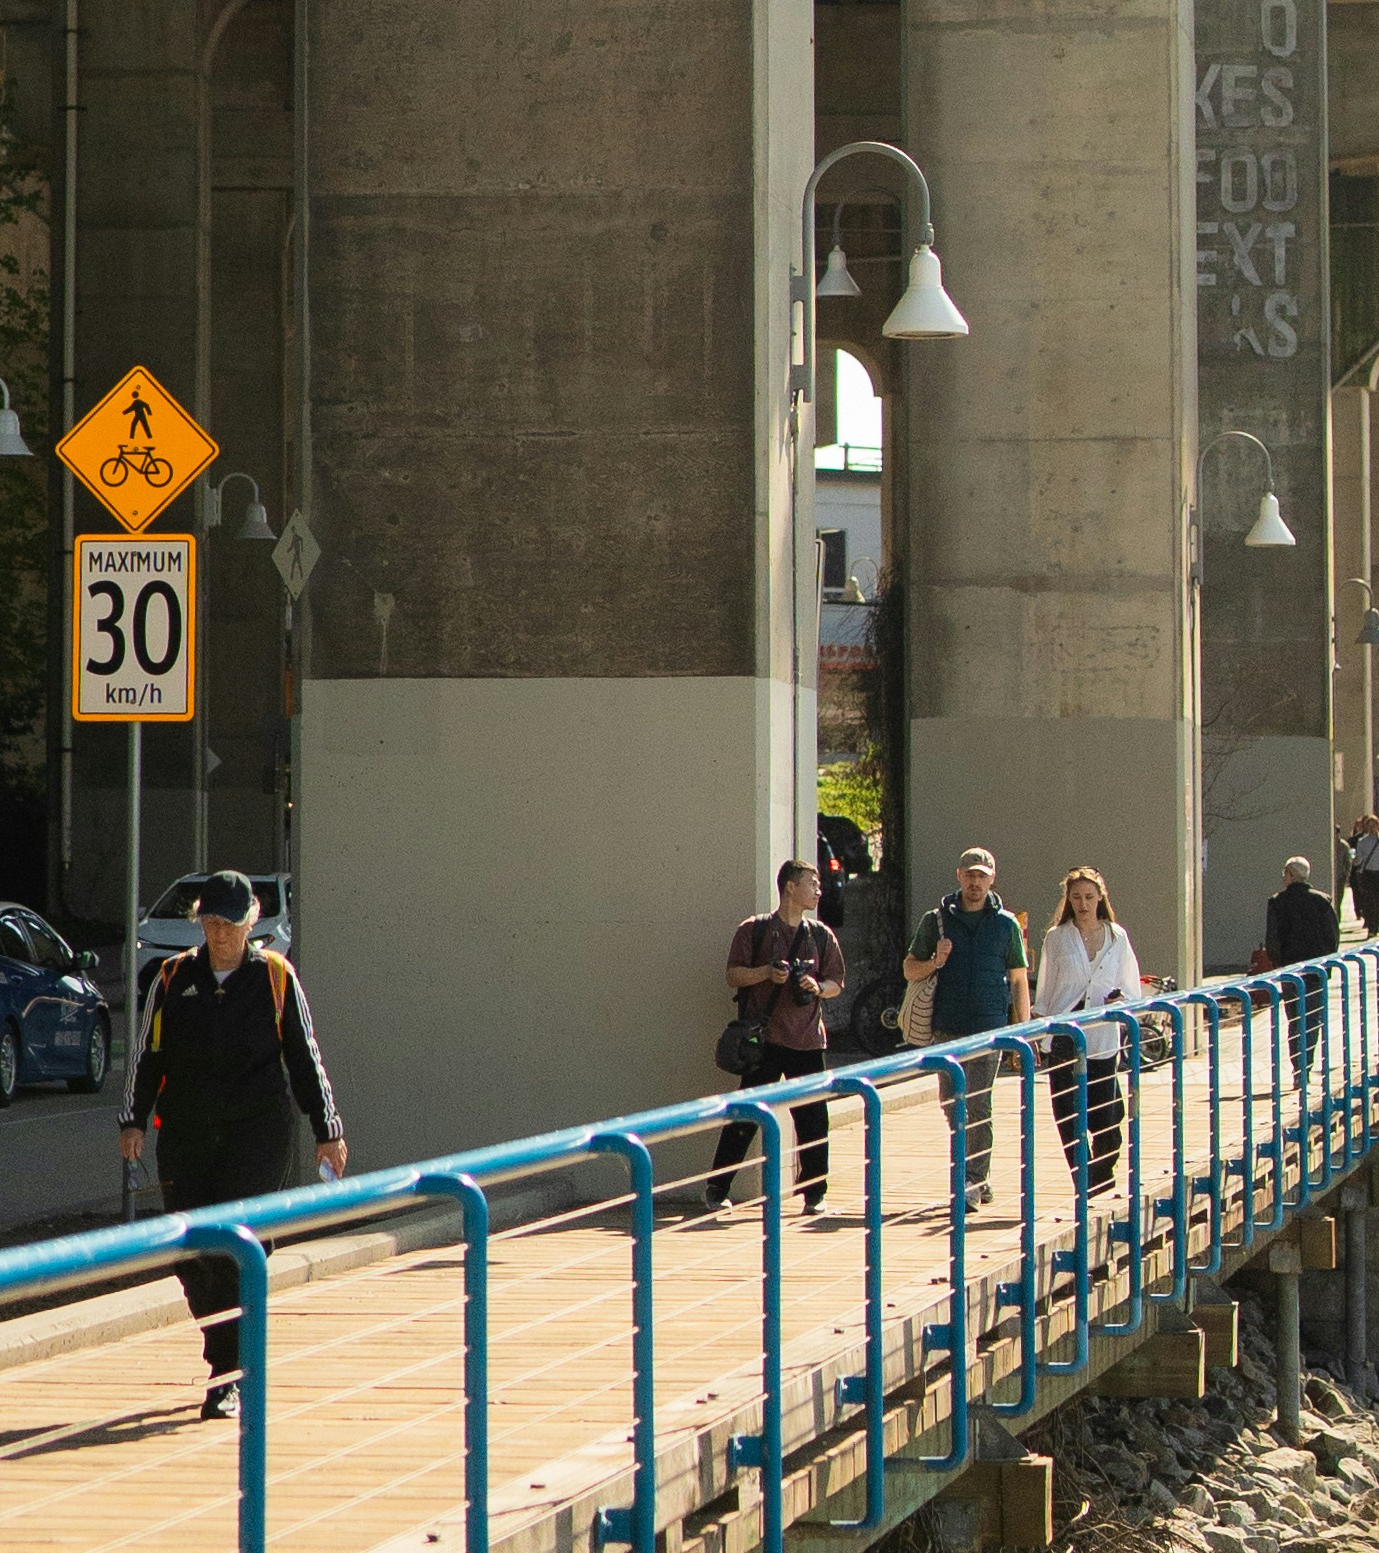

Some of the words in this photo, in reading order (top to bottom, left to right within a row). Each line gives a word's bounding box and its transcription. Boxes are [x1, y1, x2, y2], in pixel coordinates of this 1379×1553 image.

[88, 551, 182, 573] MAXIMUM
[86, 579, 182, 676] 30
[106, 682, 162, 706] km/h
